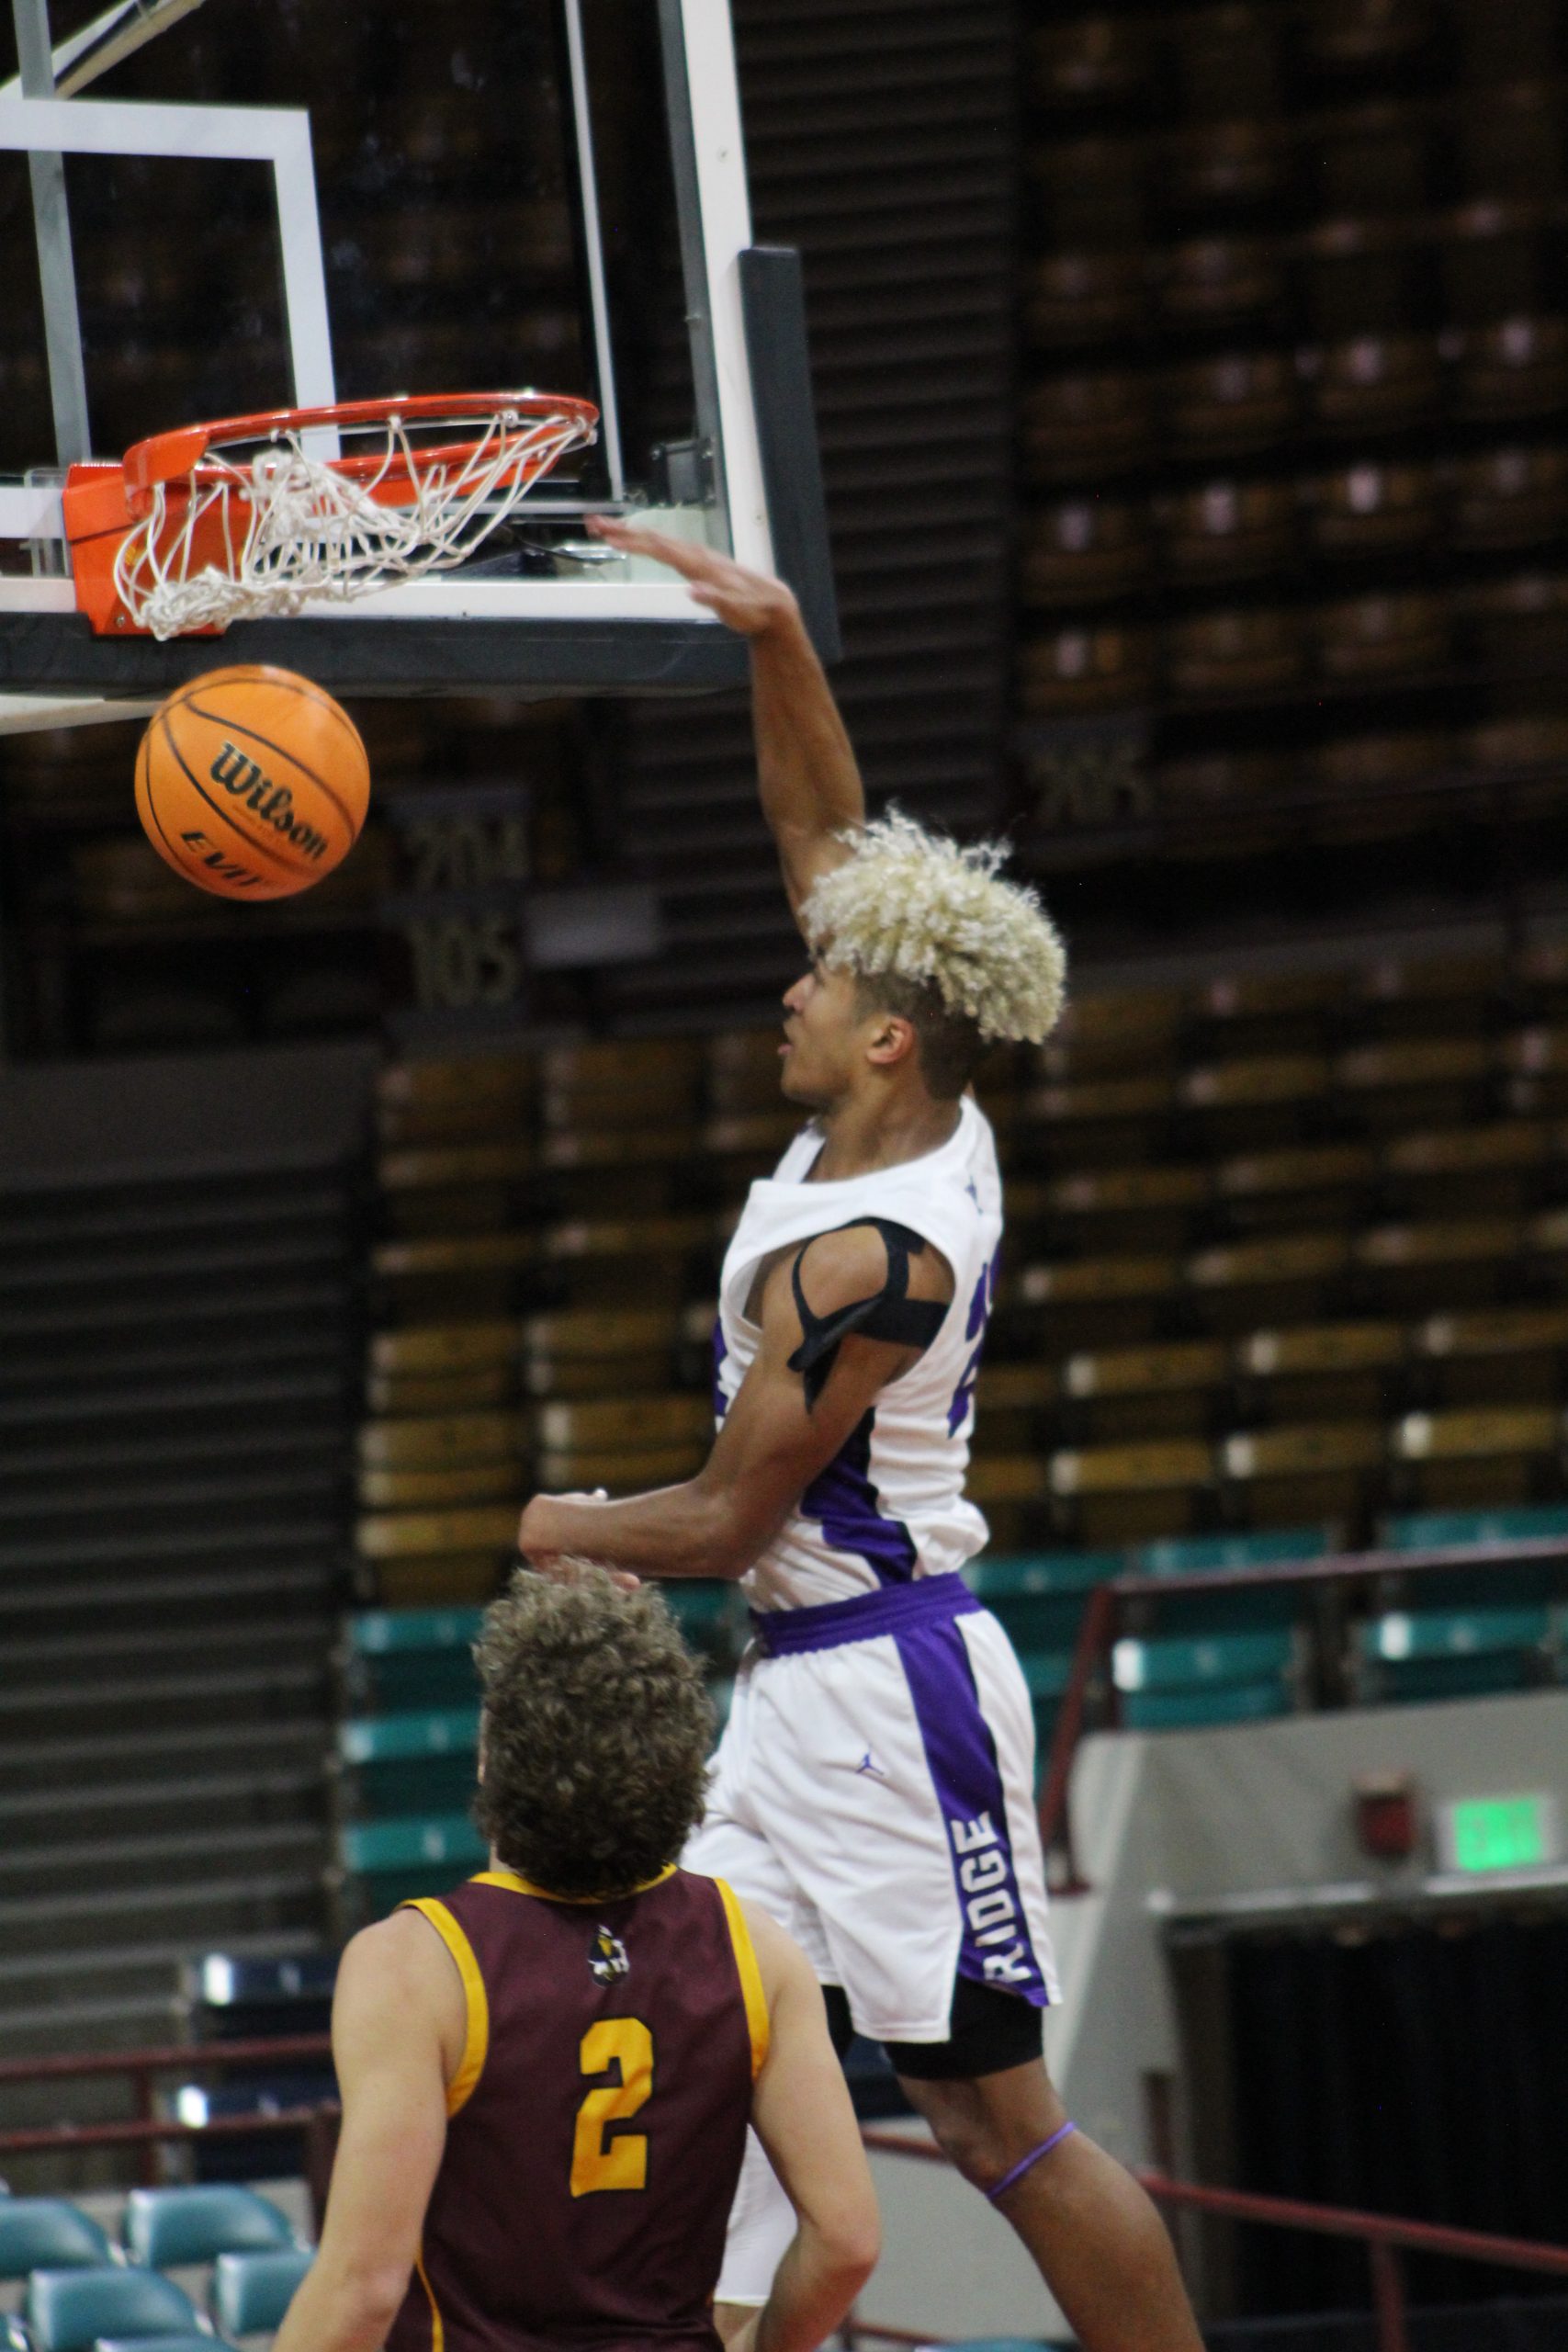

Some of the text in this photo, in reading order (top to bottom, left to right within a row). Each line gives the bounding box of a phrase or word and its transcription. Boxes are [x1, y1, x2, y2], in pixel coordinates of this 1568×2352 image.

[210, 741, 328, 861] Wilson
[951, 1811, 1032, 1983] RIDGE
[570, 2018, 653, 2198] 2
